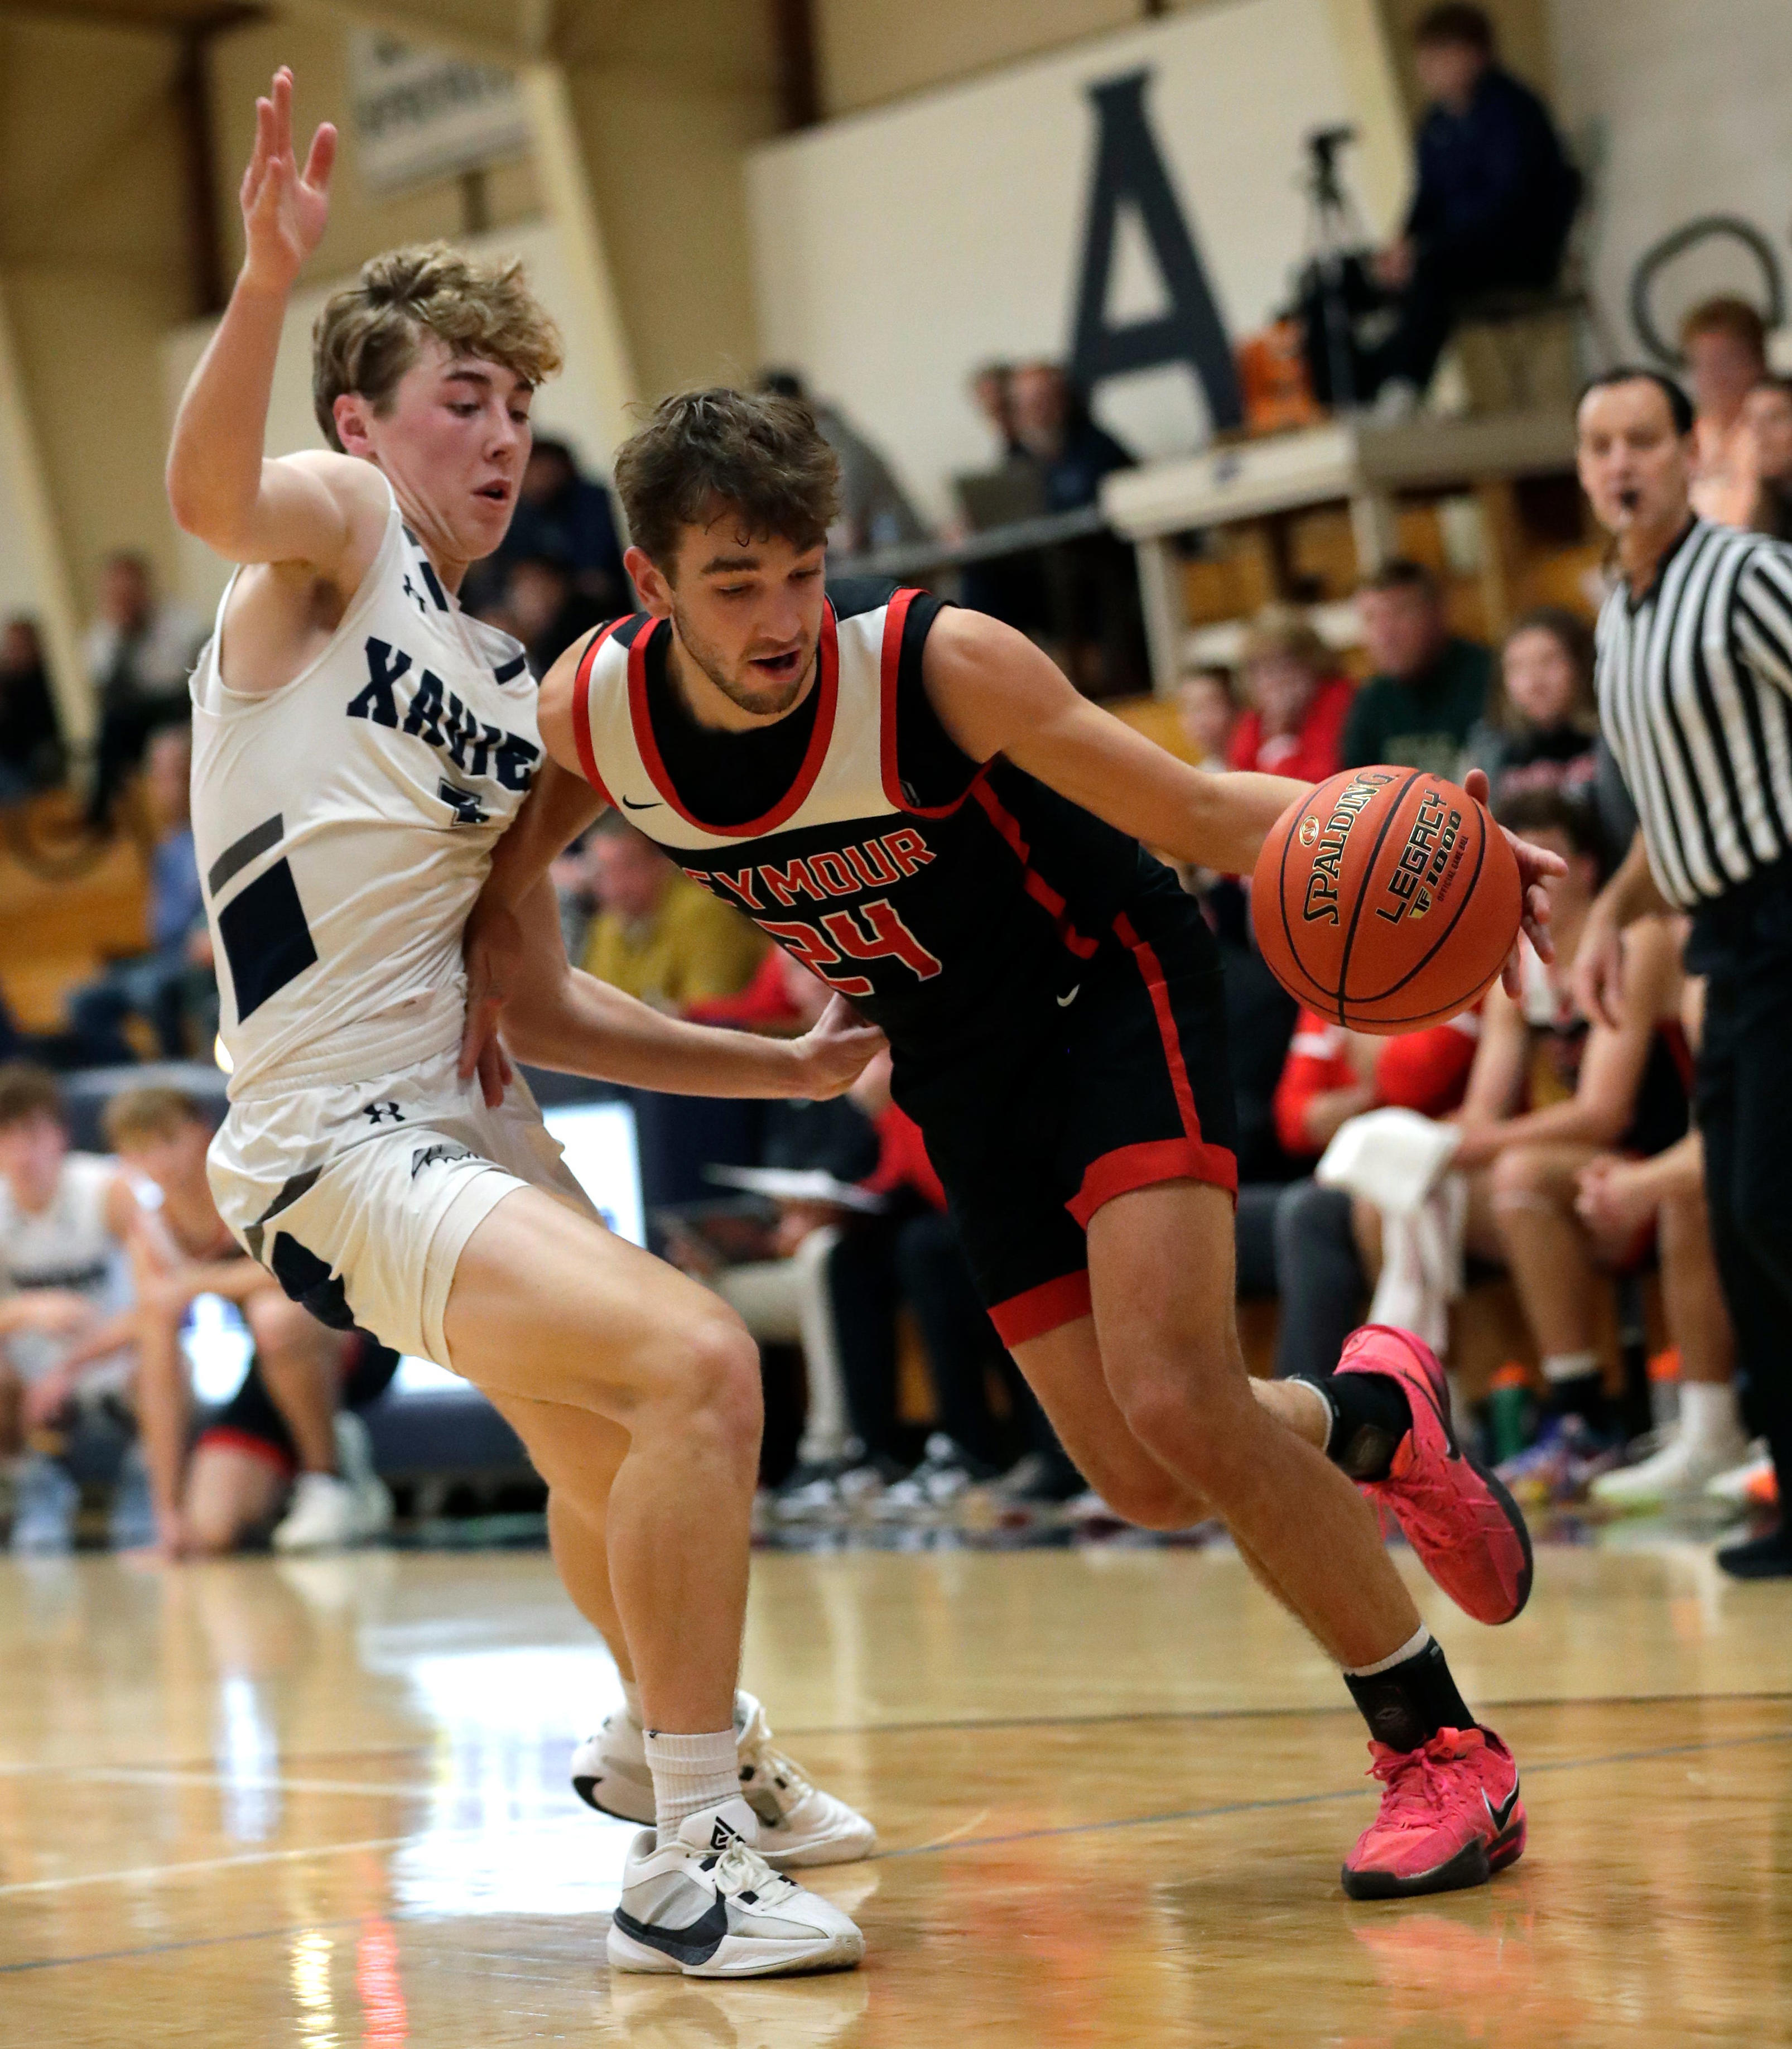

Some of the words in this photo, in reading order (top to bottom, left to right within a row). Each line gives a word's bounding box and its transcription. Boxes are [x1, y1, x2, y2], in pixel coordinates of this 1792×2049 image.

[1303, 772, 1396, 926] SPALDING
[1375, 788, 1447, 925] LEGACY
[1437, 870, 1456, 902] OFFICIAL
[1451, 850, 1464, 870] GAME
[1458, 835, 1469, 851] BALL
[752, 898, 942, 996] 24
